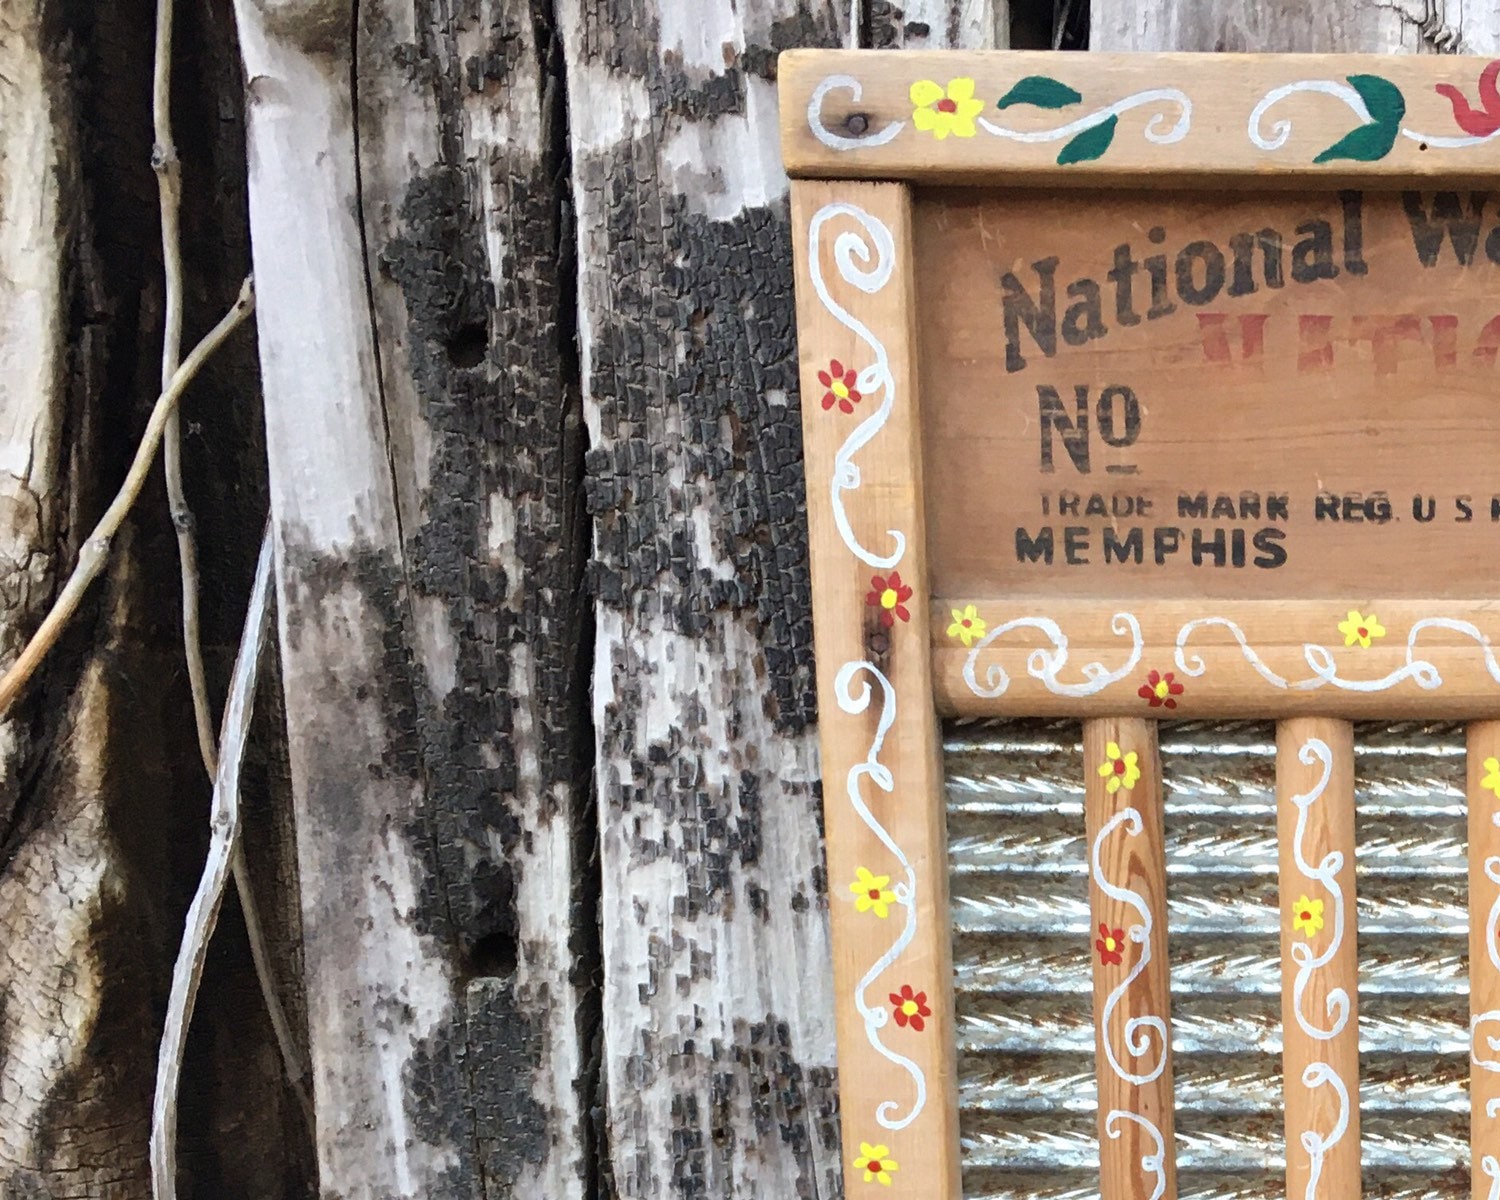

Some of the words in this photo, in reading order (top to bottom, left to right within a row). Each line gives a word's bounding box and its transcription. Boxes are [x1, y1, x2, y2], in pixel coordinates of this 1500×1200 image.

[1001, 188, 1368, 373] National
[1040, 489, 1154, 519] TRADE
[1177, 490, 1290, 522] MARK
[1412, 493, 1436, 523] U
[1454, 494, 1473, 523] S
[1014, 526, 1288, 570] MEMPHIS
